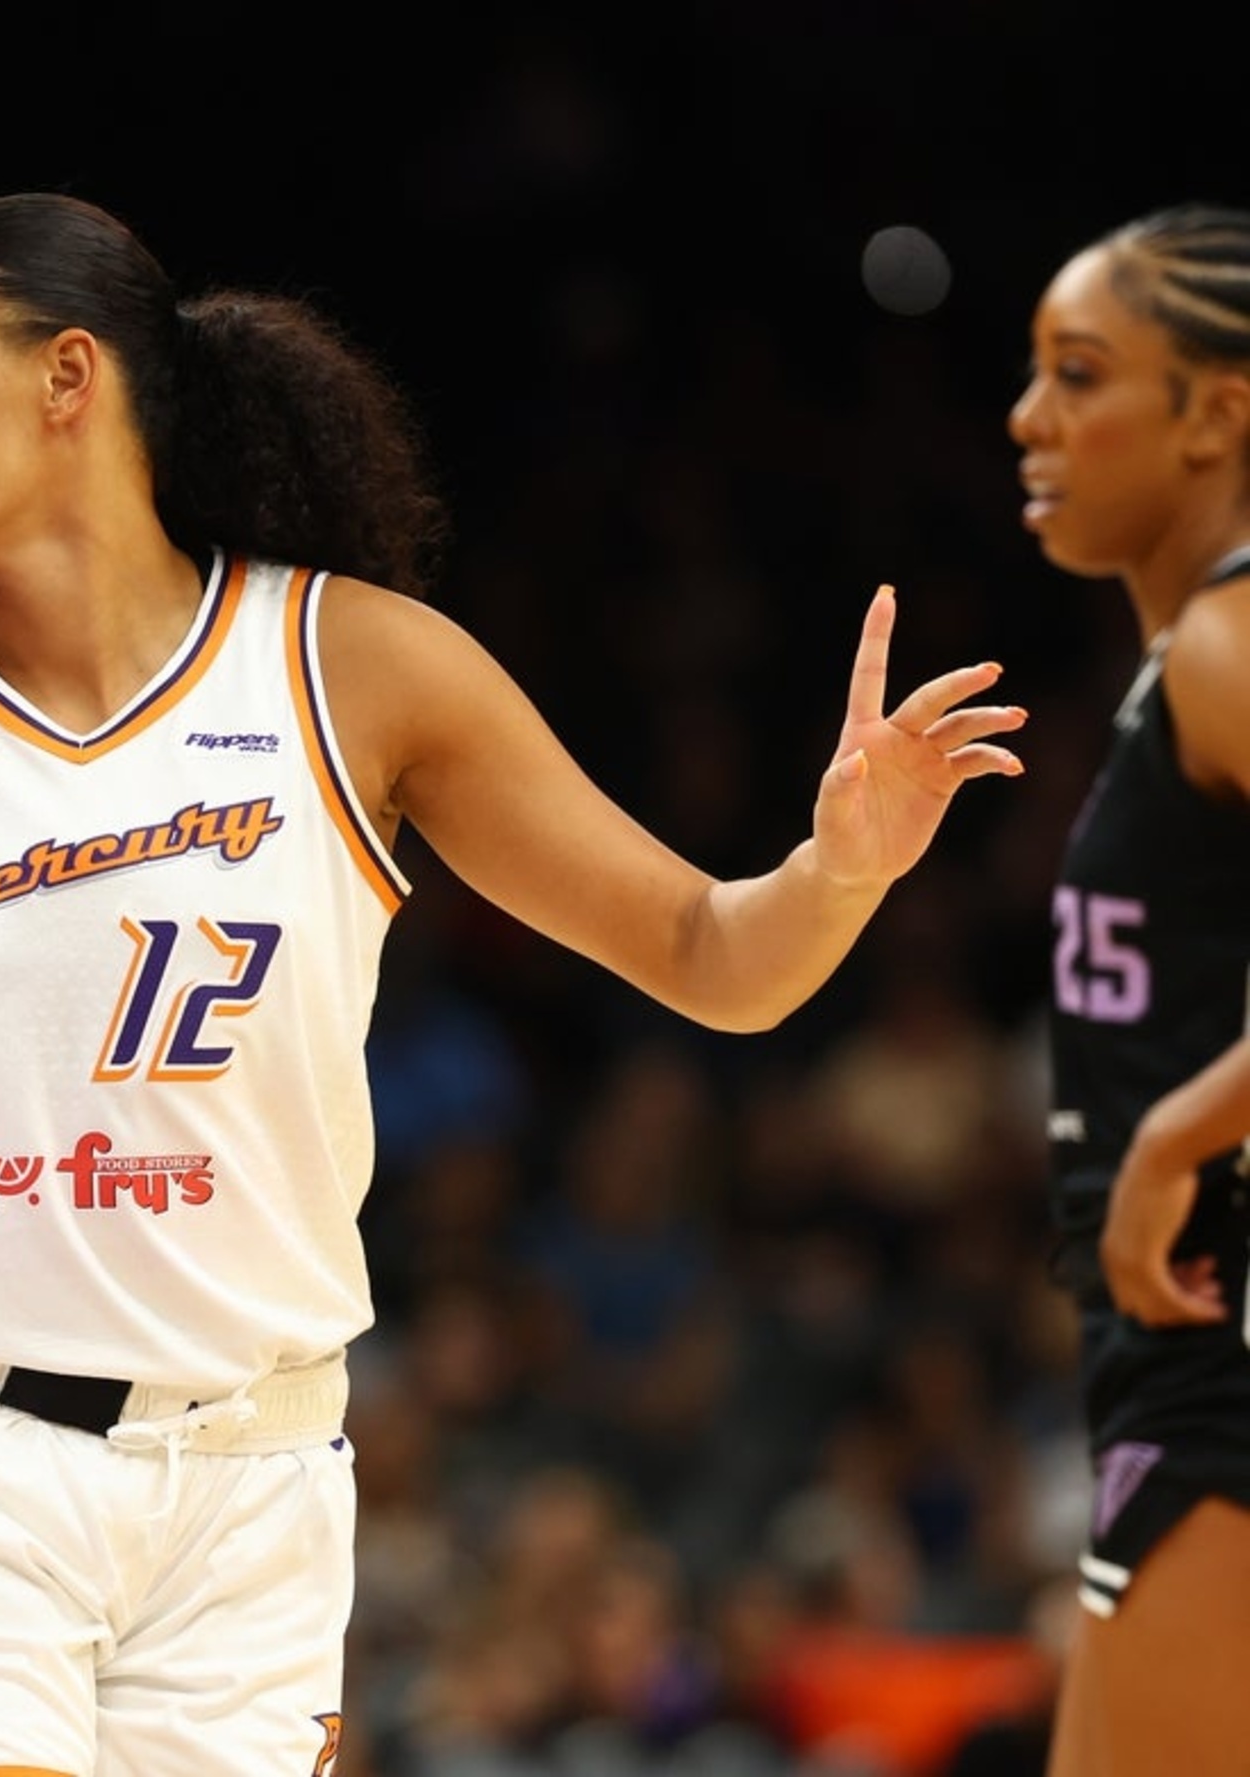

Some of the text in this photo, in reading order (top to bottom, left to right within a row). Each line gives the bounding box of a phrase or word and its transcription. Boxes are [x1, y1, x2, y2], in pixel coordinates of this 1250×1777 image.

[92, 917, 282, 1082] 12
[1052, 884, 1151, 1024] 25
[56, 1131, 215, 1215] fry's
[96, 1156, 206, 1171] FOOD STORES
